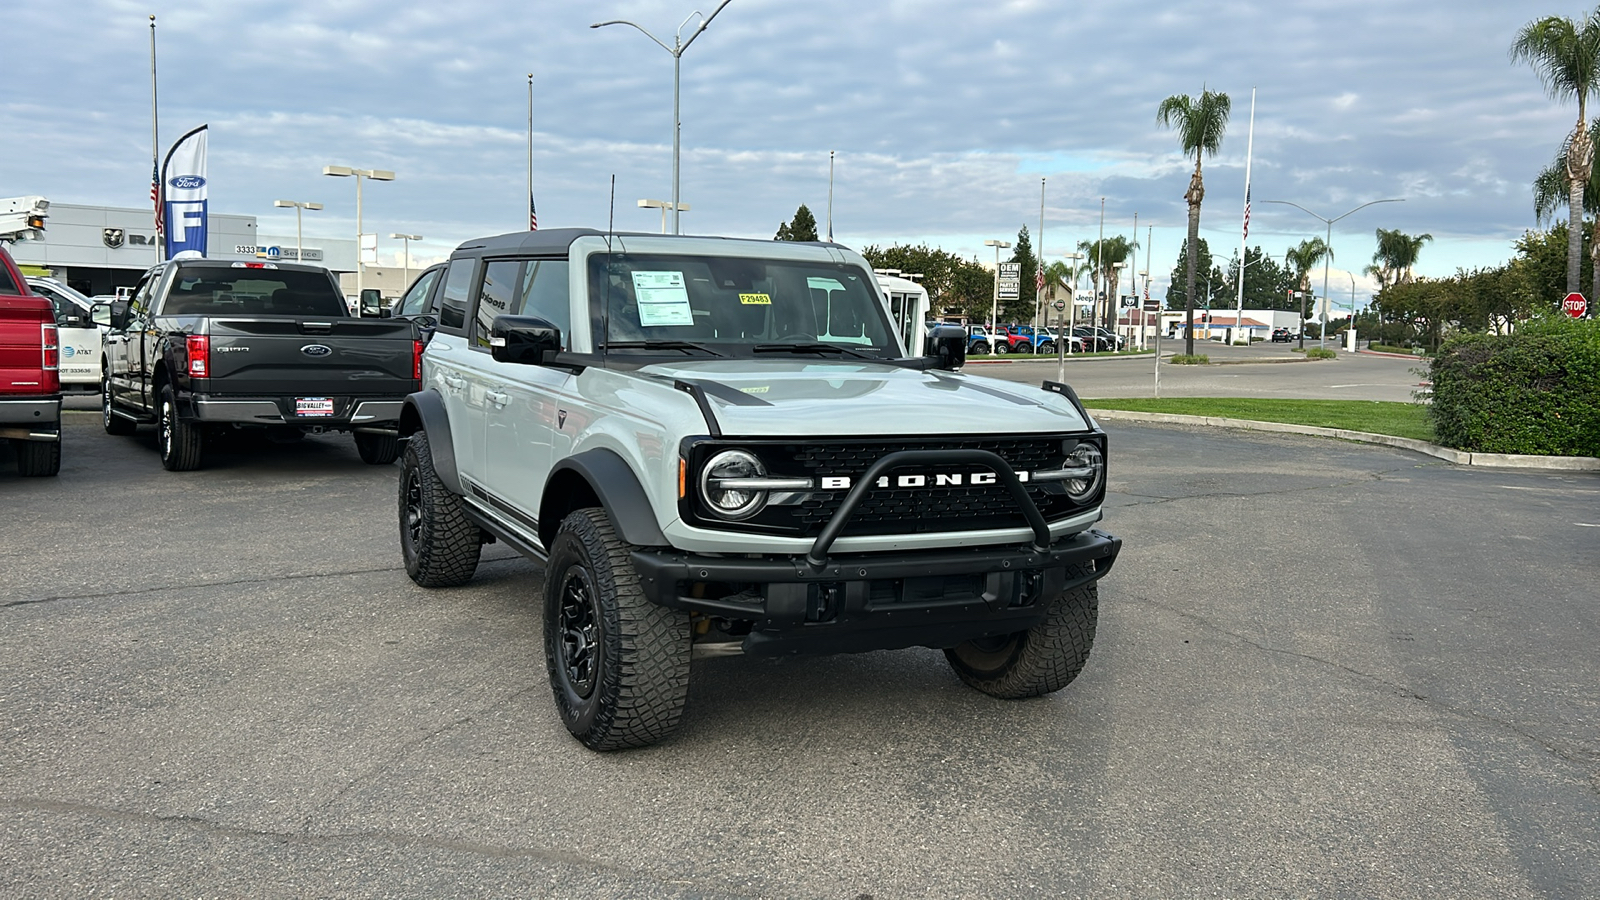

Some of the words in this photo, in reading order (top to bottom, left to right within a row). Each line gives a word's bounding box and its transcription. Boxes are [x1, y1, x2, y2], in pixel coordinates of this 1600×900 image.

[128, 234, 164, 246] RA
[236, 245, 255, 254] 3333
[1000, 264, 1019, 272] OEM
[740, 295, 769, 303] F29483
[1075, 294, 1094, 302] Jeep
[1564, 300, 1585, 311] STOP
